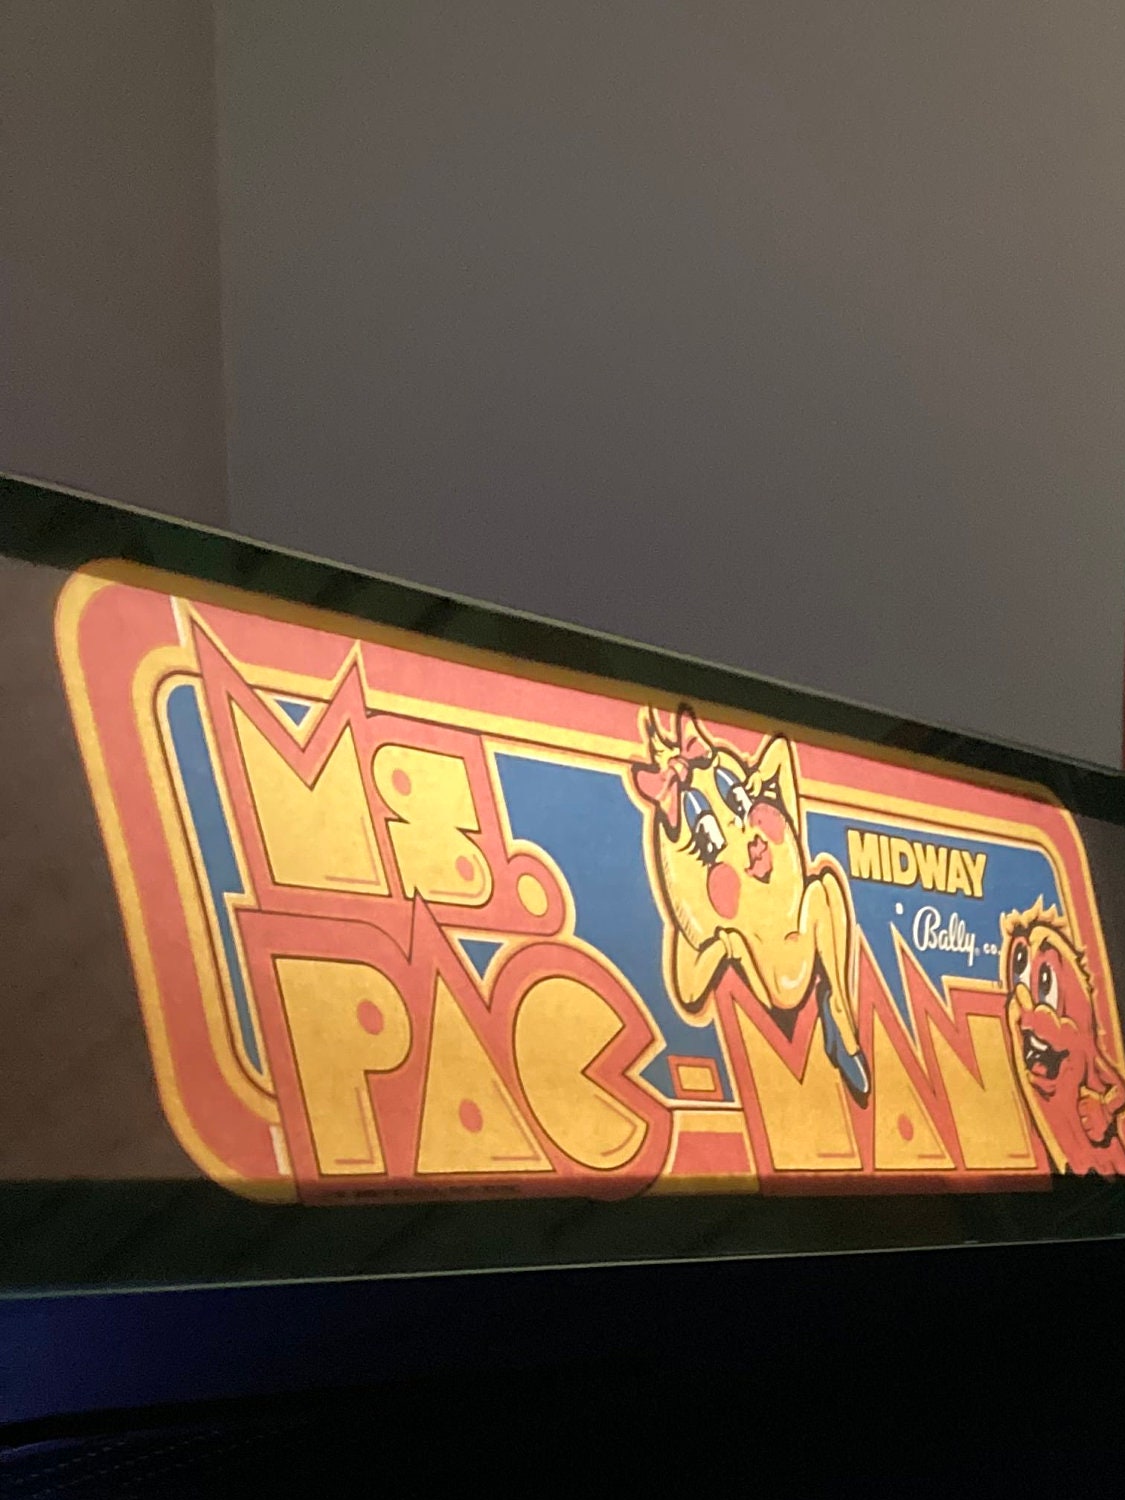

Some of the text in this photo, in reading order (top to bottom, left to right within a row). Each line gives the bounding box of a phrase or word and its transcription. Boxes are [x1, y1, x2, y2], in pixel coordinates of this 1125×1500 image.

[846, 828, 987, 899] MIDWAY
[912, 905, 976, 967] Bally
[245, 915, 1046, 1185] PAC-MAN
